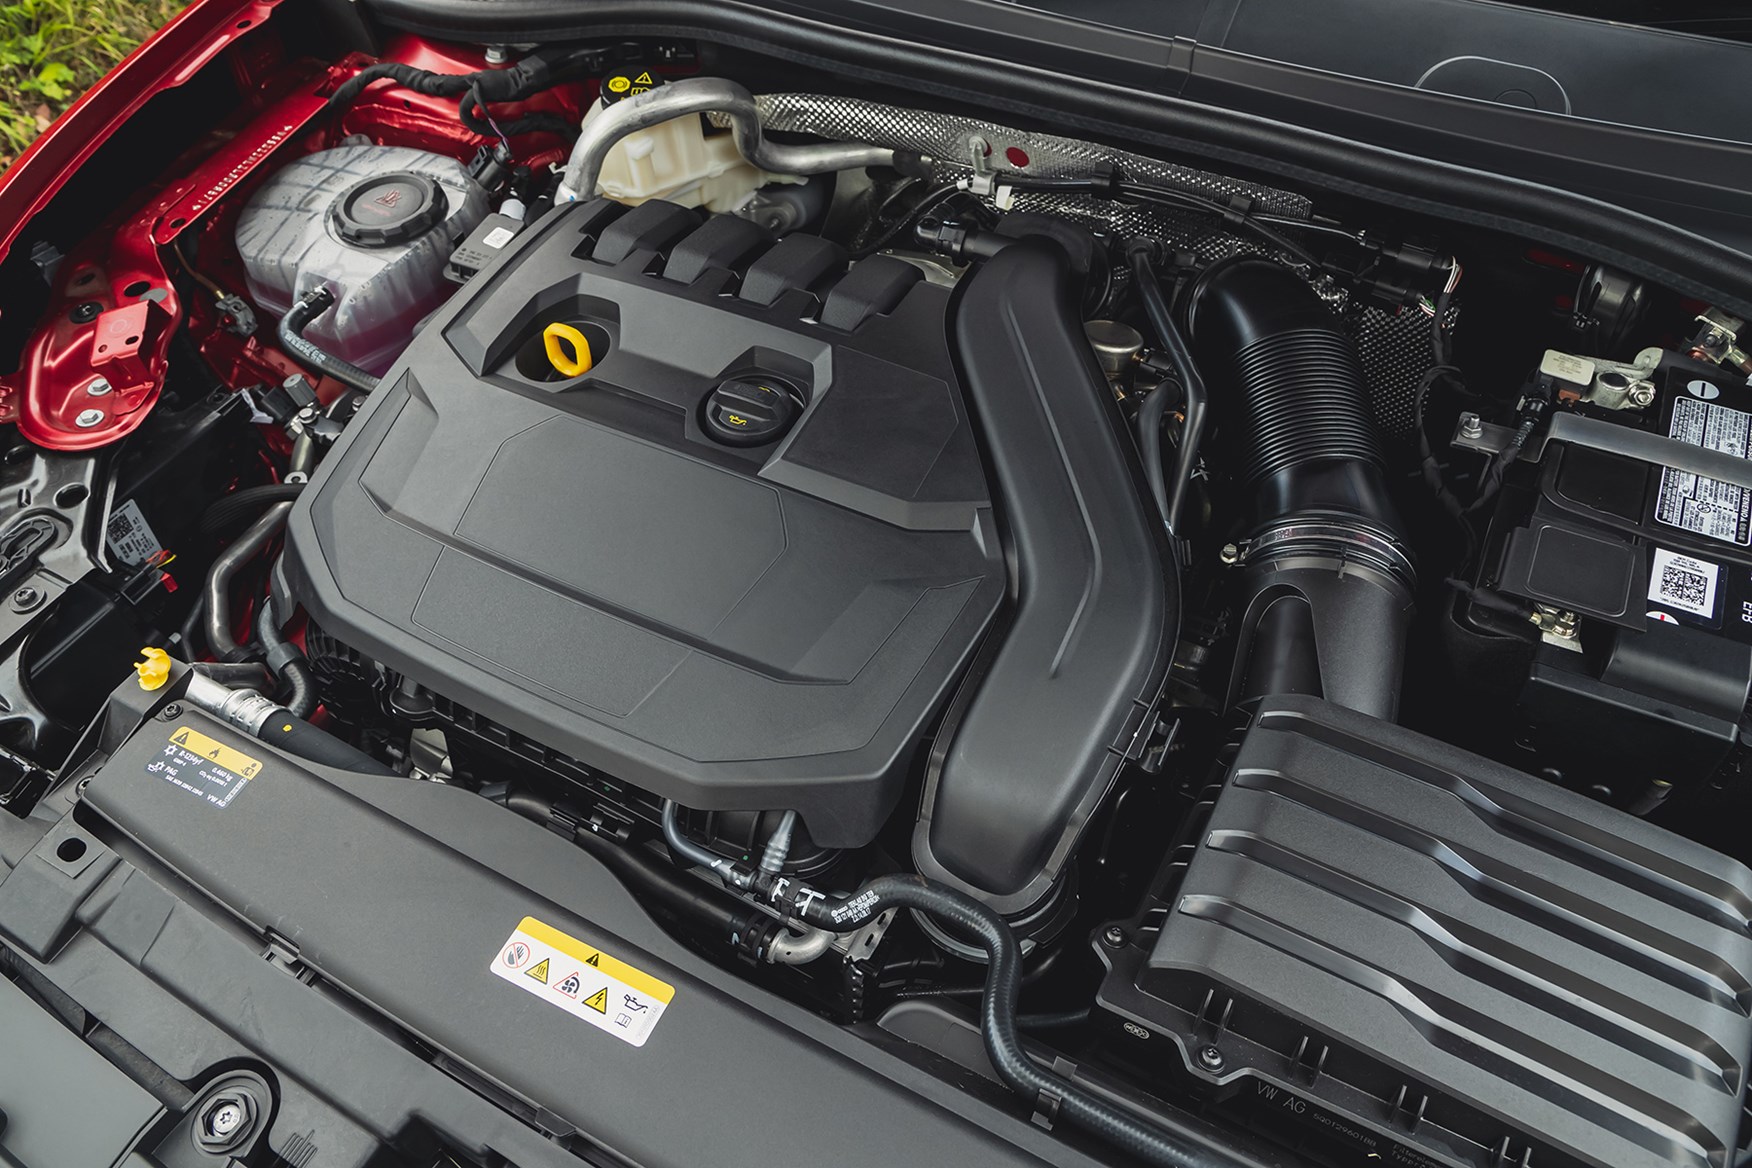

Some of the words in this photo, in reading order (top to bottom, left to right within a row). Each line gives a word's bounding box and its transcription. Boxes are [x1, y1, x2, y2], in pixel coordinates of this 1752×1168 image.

[164, 765, 178, 776] PAG
[206, 794, 218, 803] VW
[216, 799, 226, 807] AG
[1257, 1081, 1278, 1100] VW
[1283, 1097, 1306, 1113] AG
